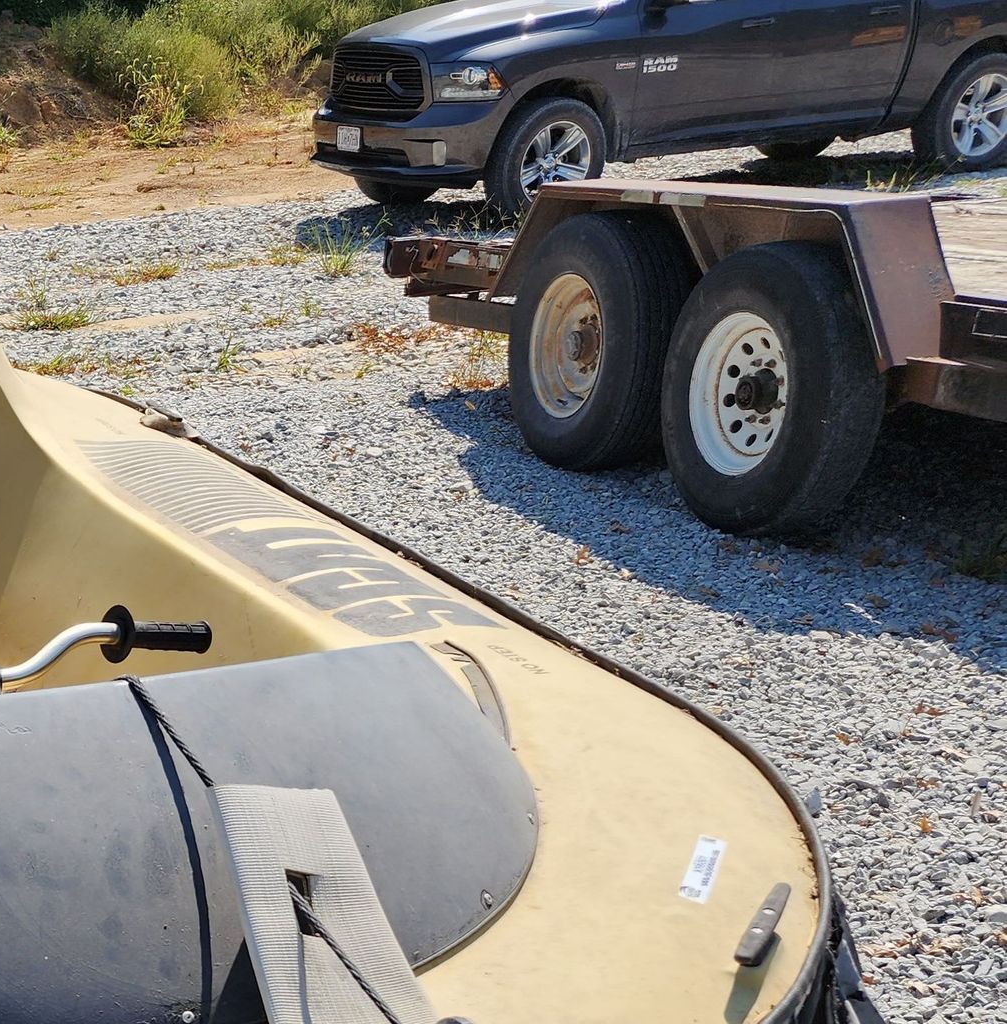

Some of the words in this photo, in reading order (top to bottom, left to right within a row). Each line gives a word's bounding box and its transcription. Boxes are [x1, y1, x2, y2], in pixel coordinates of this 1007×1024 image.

[644, 55, 678, 66] RAM
[643, 64, 677, 73] 1500
[345, 72, 382, 83] RAM
[487, 644, 528, 662] STEP
[521, 663, 551, 675] NO
